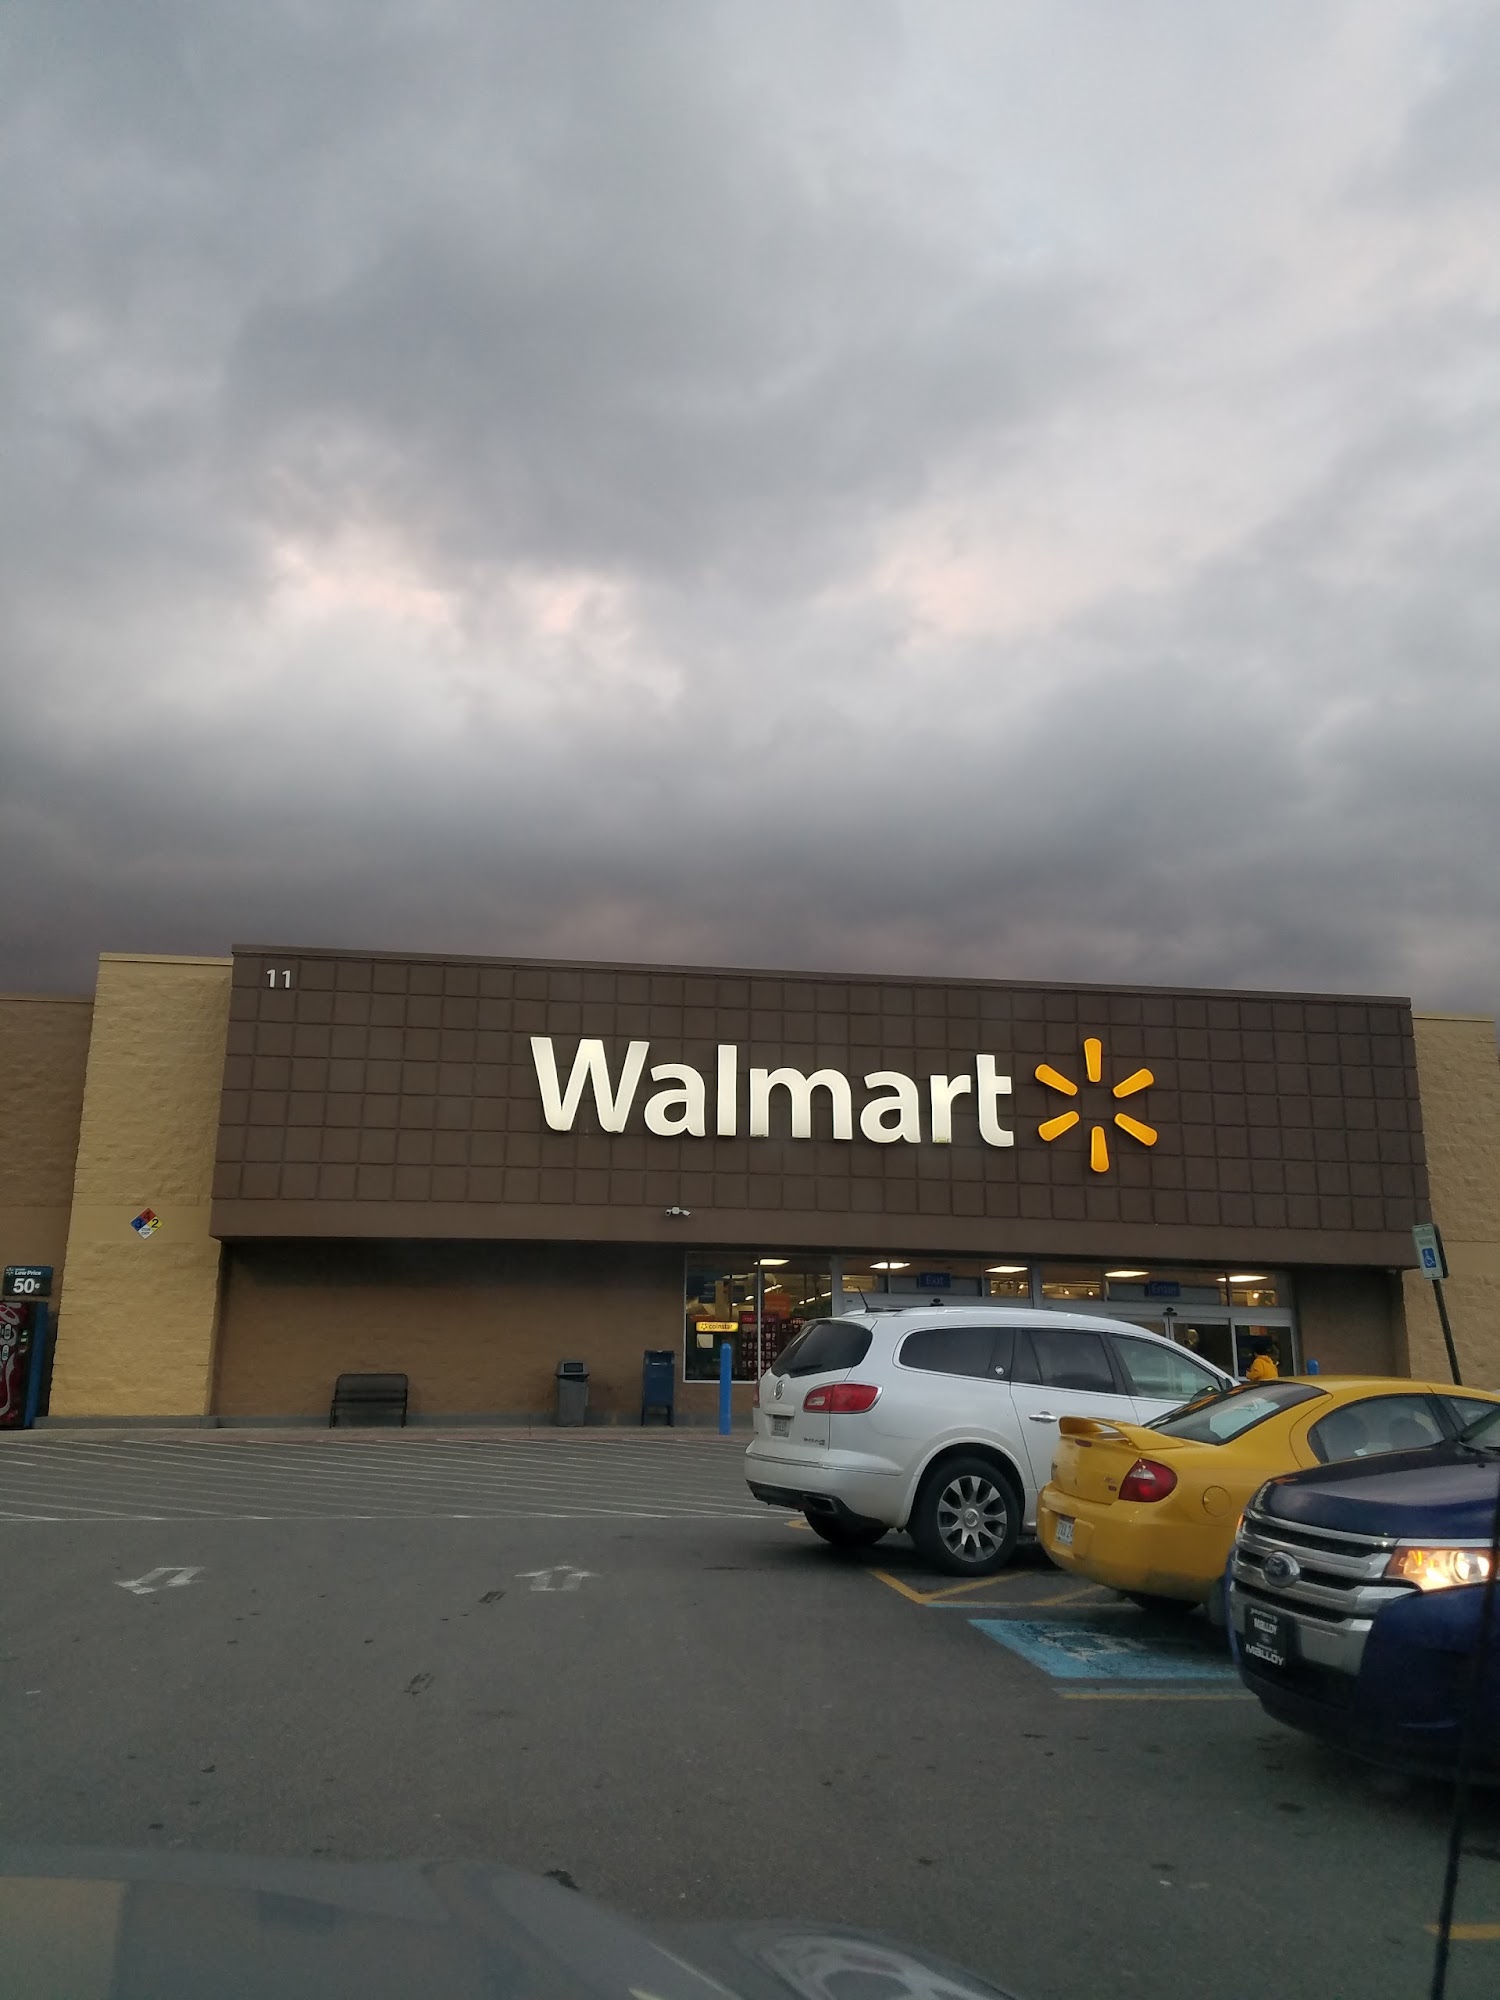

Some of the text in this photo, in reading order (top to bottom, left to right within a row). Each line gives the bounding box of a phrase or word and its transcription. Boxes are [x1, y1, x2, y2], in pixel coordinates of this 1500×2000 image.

[266, 969, 291, 988] 11
[530, 1037, 1014, 1147] Walmart
[143, 1211, 150, 1220] 4
[135, 1219, 142, 1228] 3
[151, 1218, 159, 1228] 2
[926, 1275, 944, 1286] Exit
[1152, 1283, 1176, 1294] Enter
